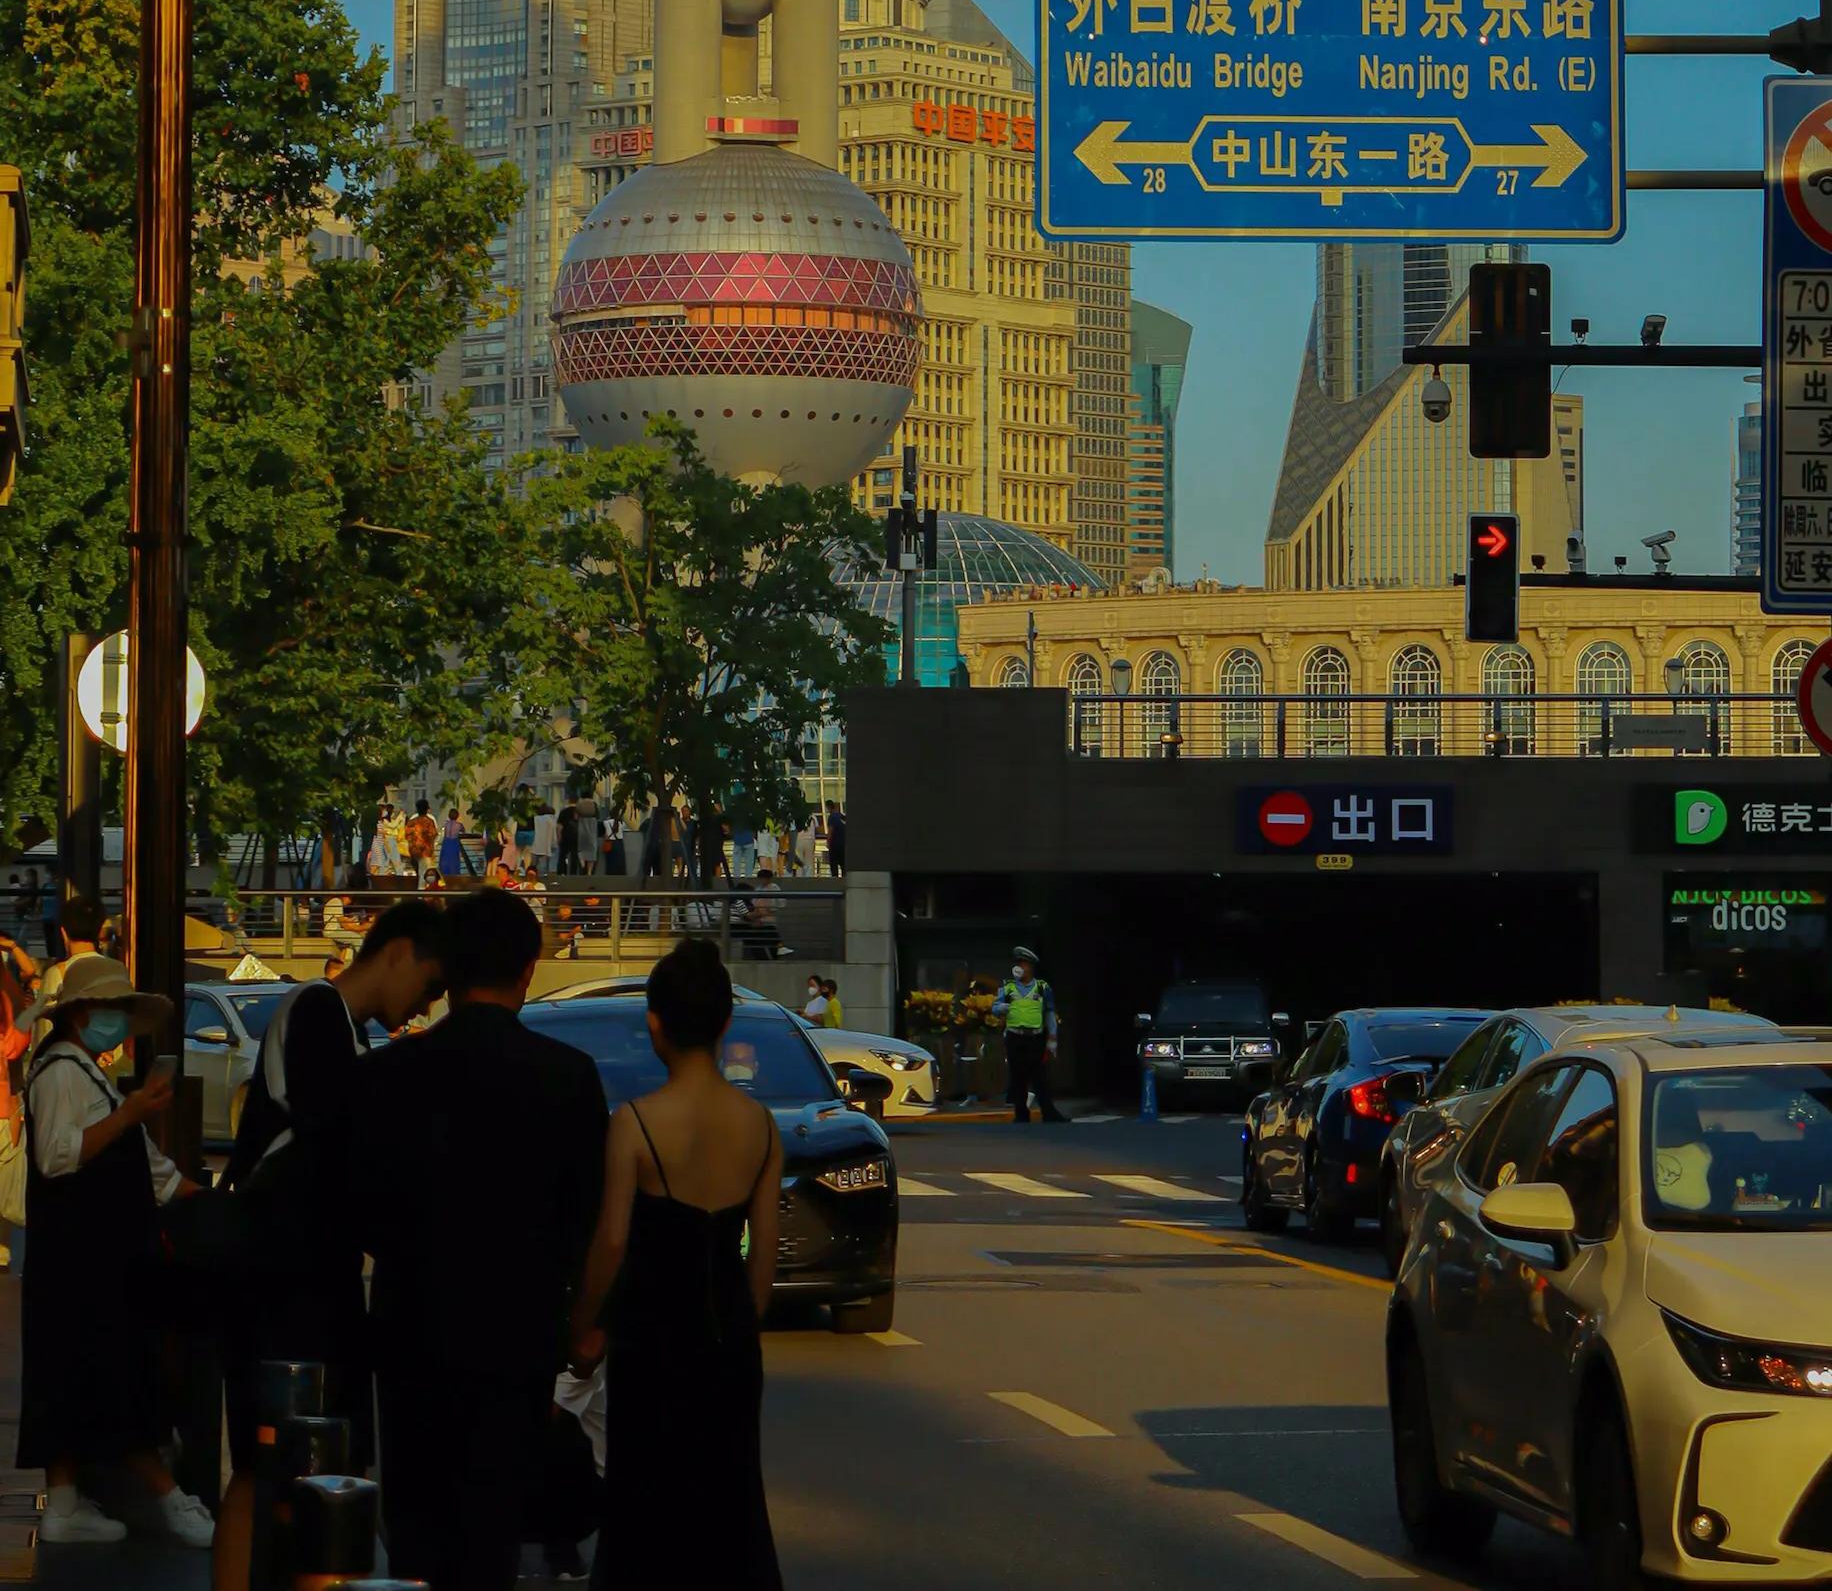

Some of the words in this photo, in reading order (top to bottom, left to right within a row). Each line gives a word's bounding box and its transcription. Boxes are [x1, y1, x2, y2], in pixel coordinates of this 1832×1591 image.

[1065, 51, 1192, 89] Waibaidu
[1214, 53, 1303, 97] Bridge
[1359, 54, 1469, 99] Nanjing
[1489, 56, 1538, 91] Rd.
[1558, 56, 1596, 92] (E)
[913, 98, 1035, 151] 中国平安
[1212, 130, 1450, 181] 中山东一路
[1143, 168, 1166, 194] 28
[1496, 170, 1519, 196] 27
[1803, 370, 1827, 402] 出
[1802, 459, 1828, 493] 临
[1332, 794, 1433, 843] 出口
[1712, 899, 1787, 931] dicos
